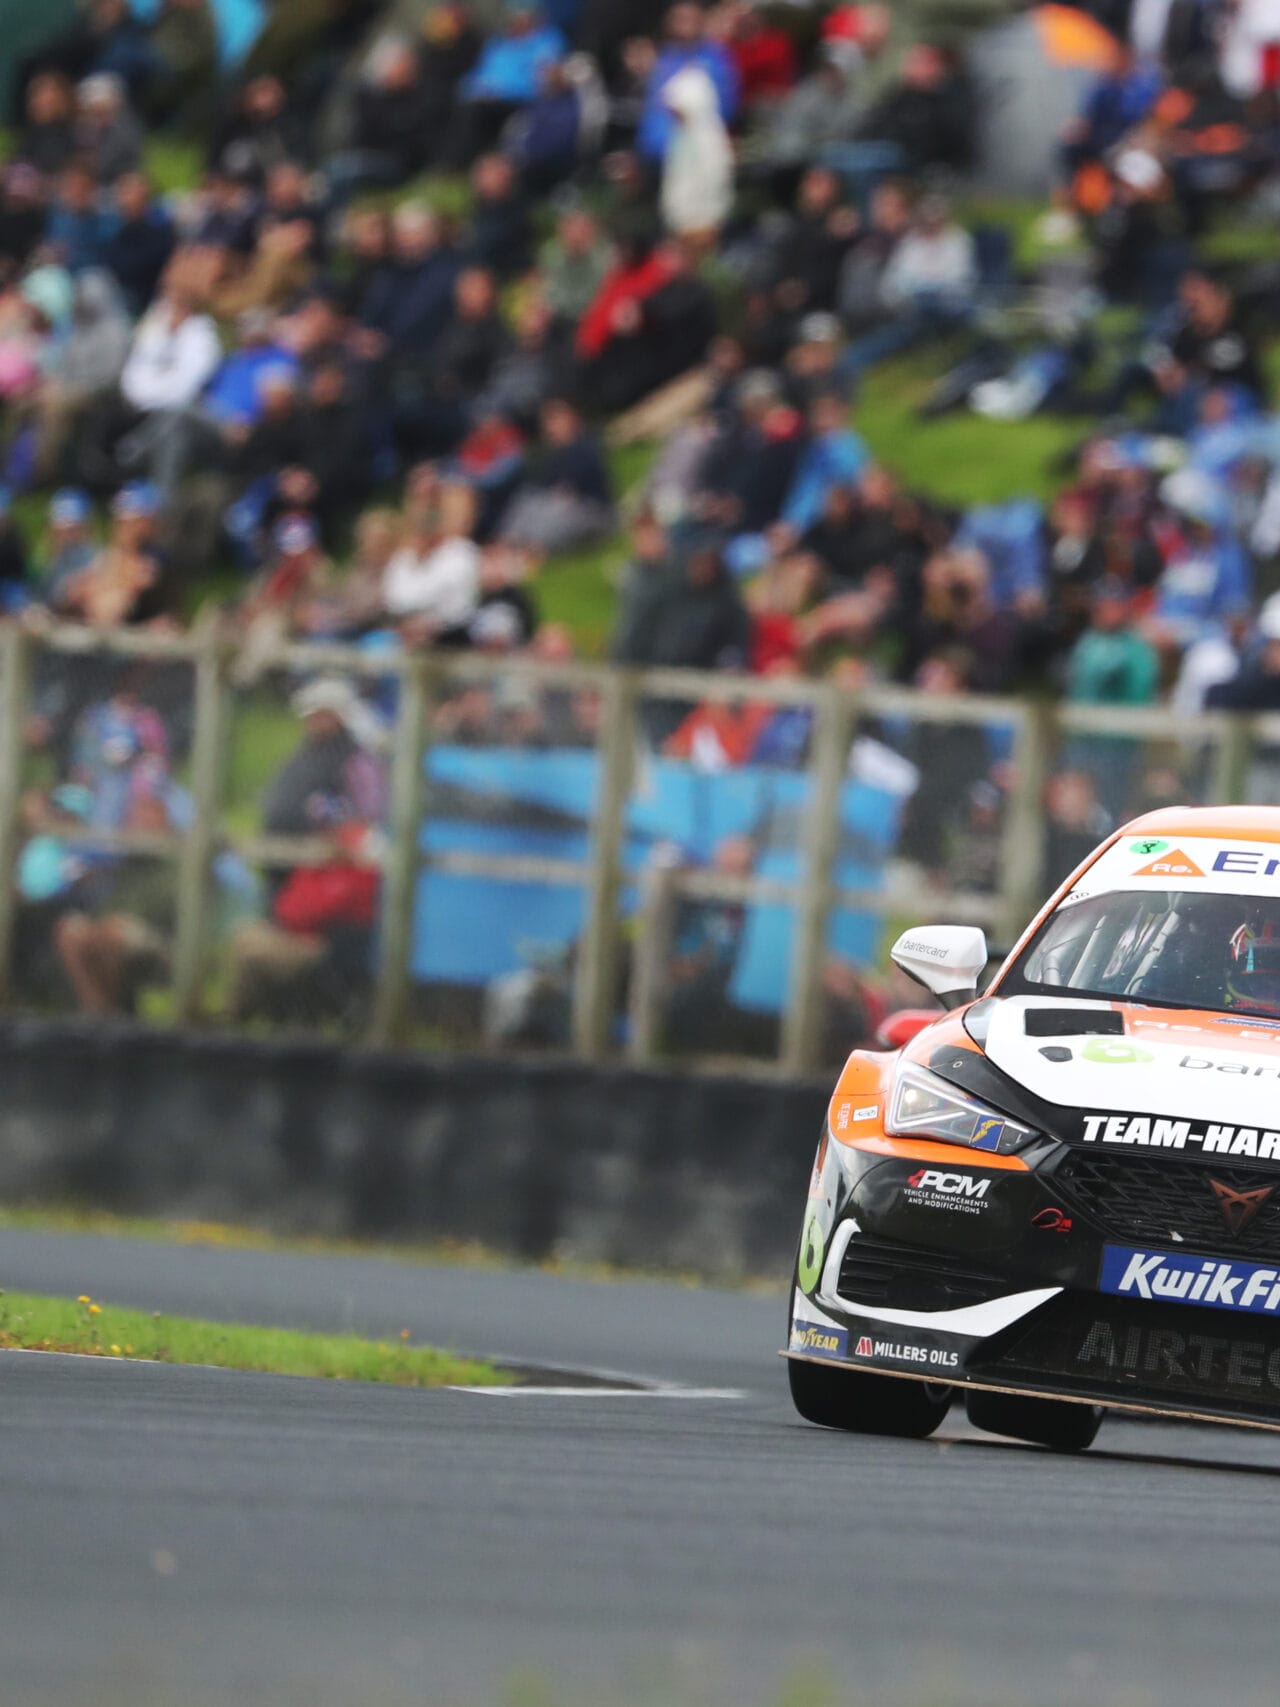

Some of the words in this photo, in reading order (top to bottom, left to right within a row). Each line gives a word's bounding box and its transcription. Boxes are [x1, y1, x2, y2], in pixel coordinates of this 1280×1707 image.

[1151, 863, 1193, 874] Re.
[904, 941, 949, 959] bartercard
[904, 1188, 929, 1199] VEHICLE
[931, 1193, 988, 1208] ENHANCEMENTS
[925, 1200, 980, 1214] MODIFICATIONS
[874, 1341, 928, 1362] MILLERS
[929, 1349, 959, 1366] OILS
